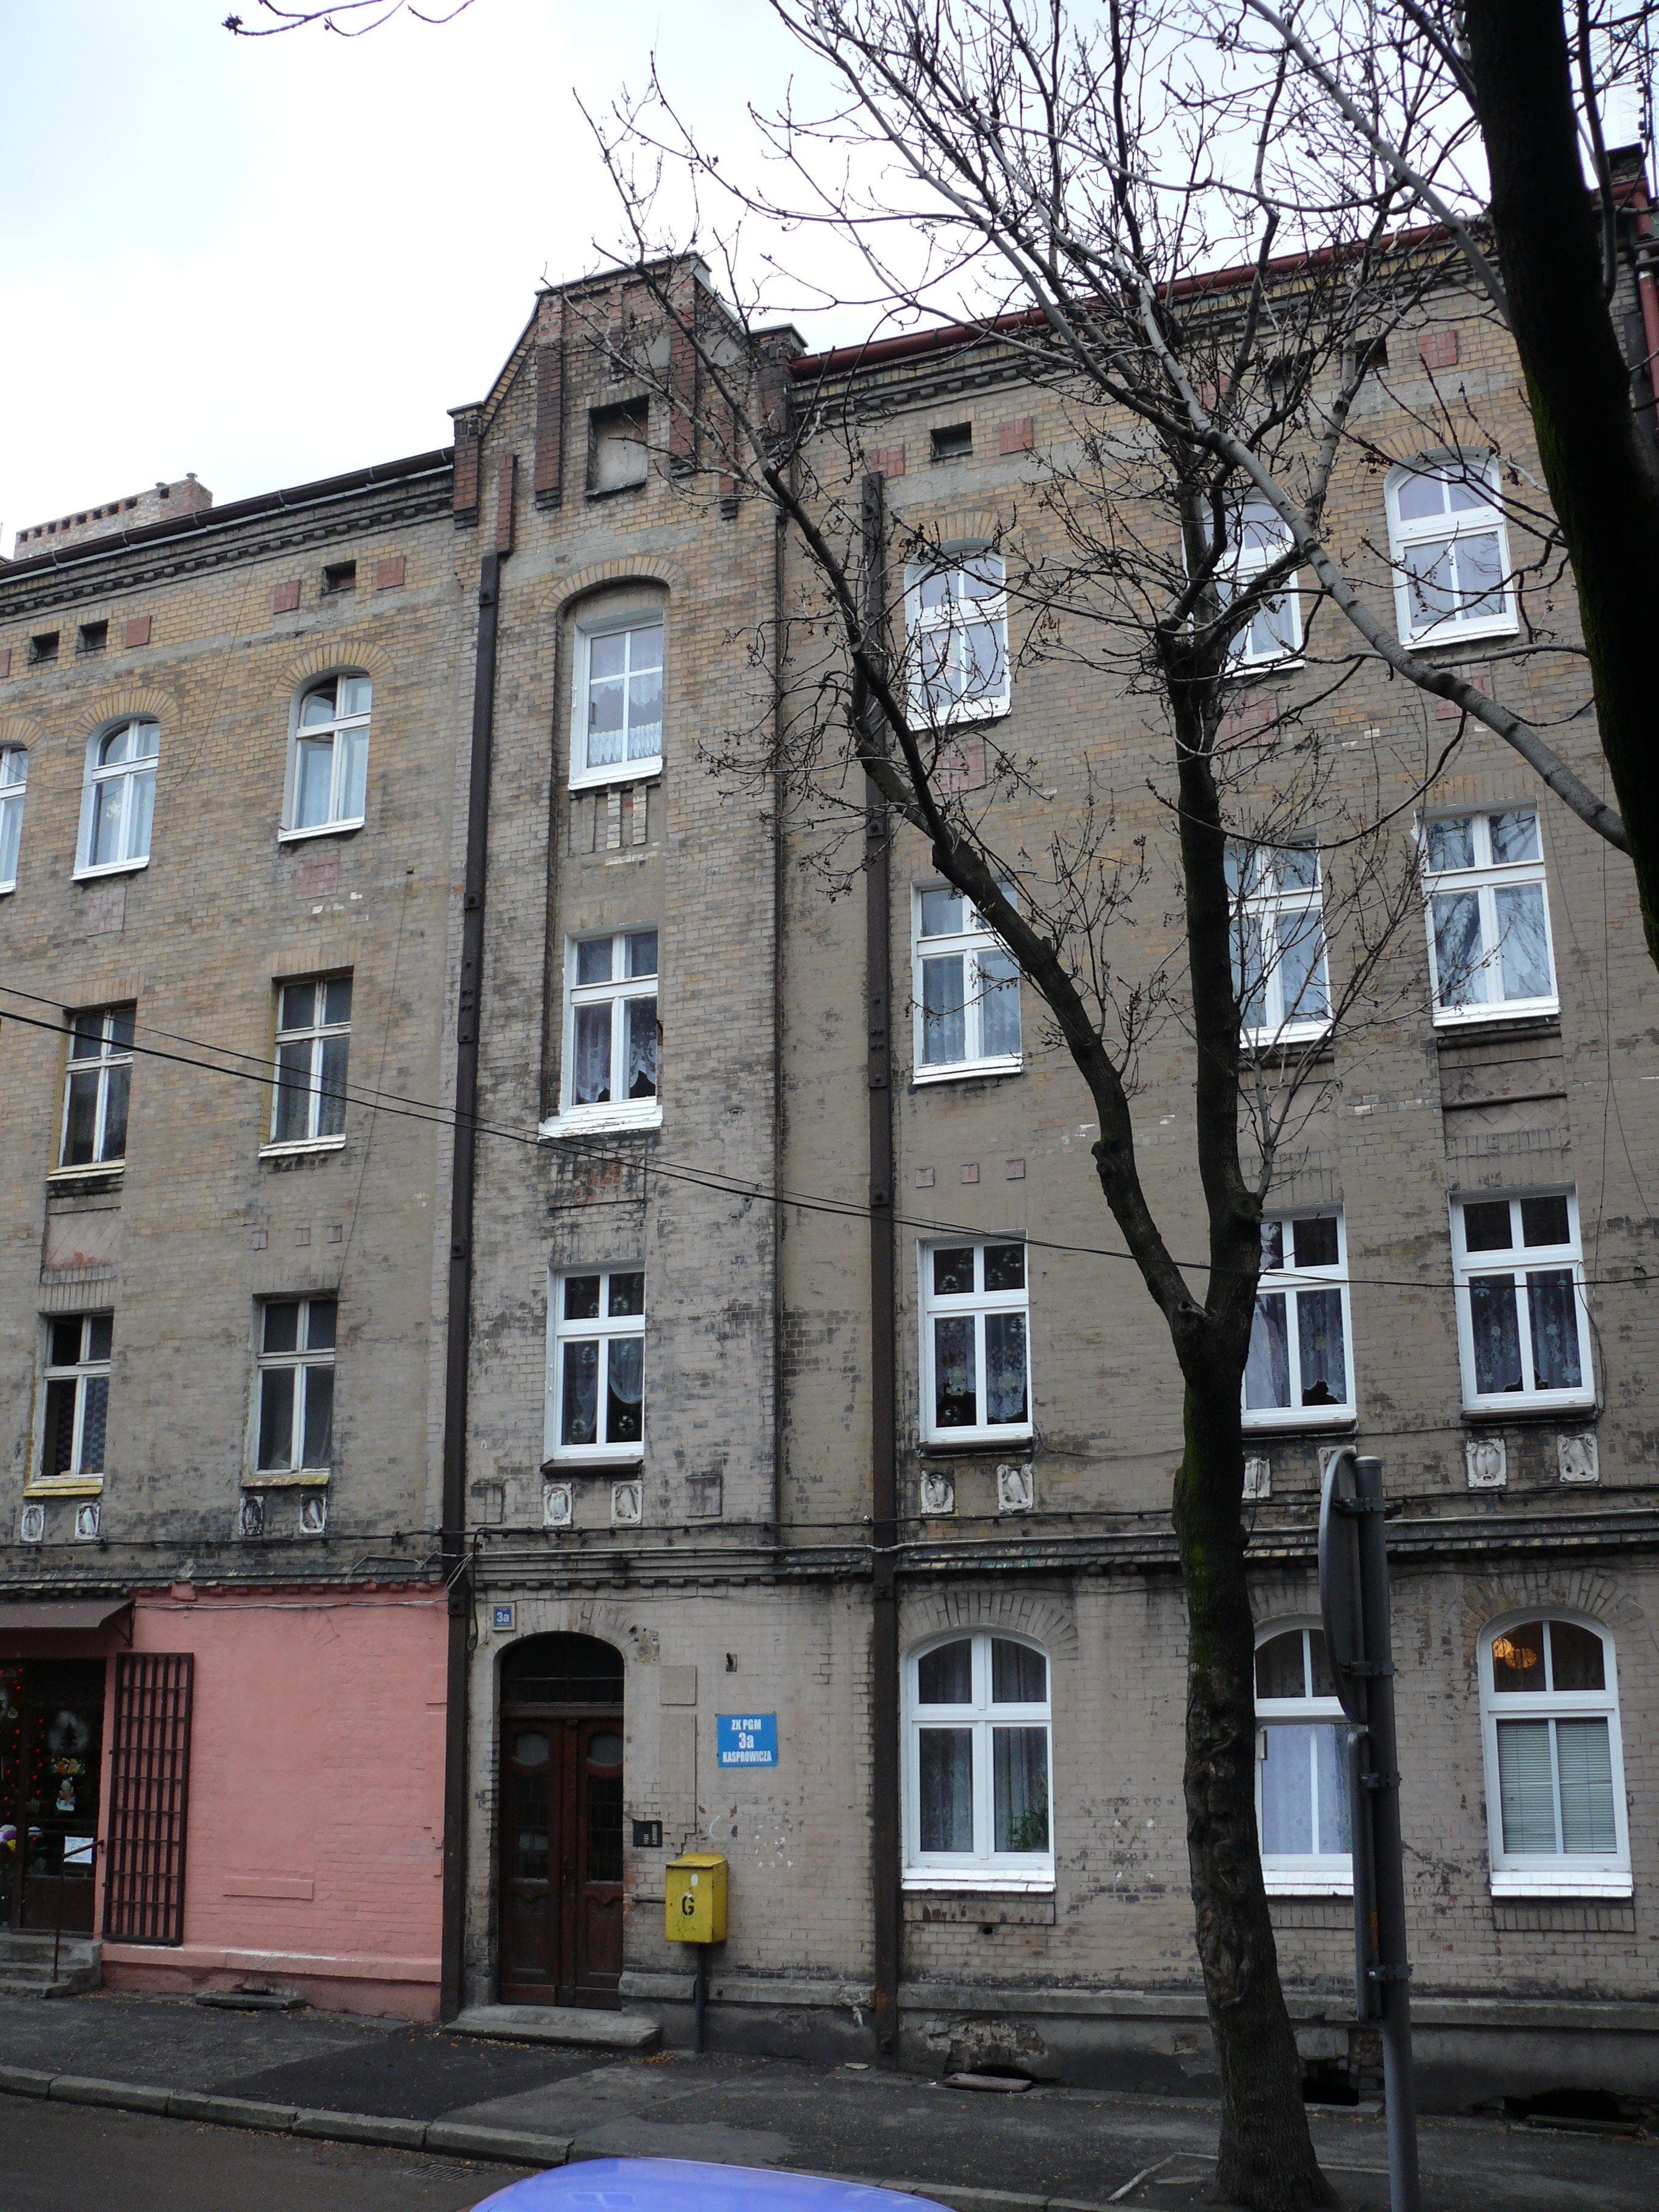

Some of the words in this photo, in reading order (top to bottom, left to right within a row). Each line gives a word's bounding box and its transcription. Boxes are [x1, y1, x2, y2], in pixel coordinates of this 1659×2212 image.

[496, 1612, 509, 1622] 3a
[731, 1719, 742, 1730] ZK
[743, 1718, 762, 1730] PGM
[739, 1732, 754, 1748] 3a
[723, 1751, 771, 1762] KASPROWICZA
[682, 1895, 694, 1916] G
